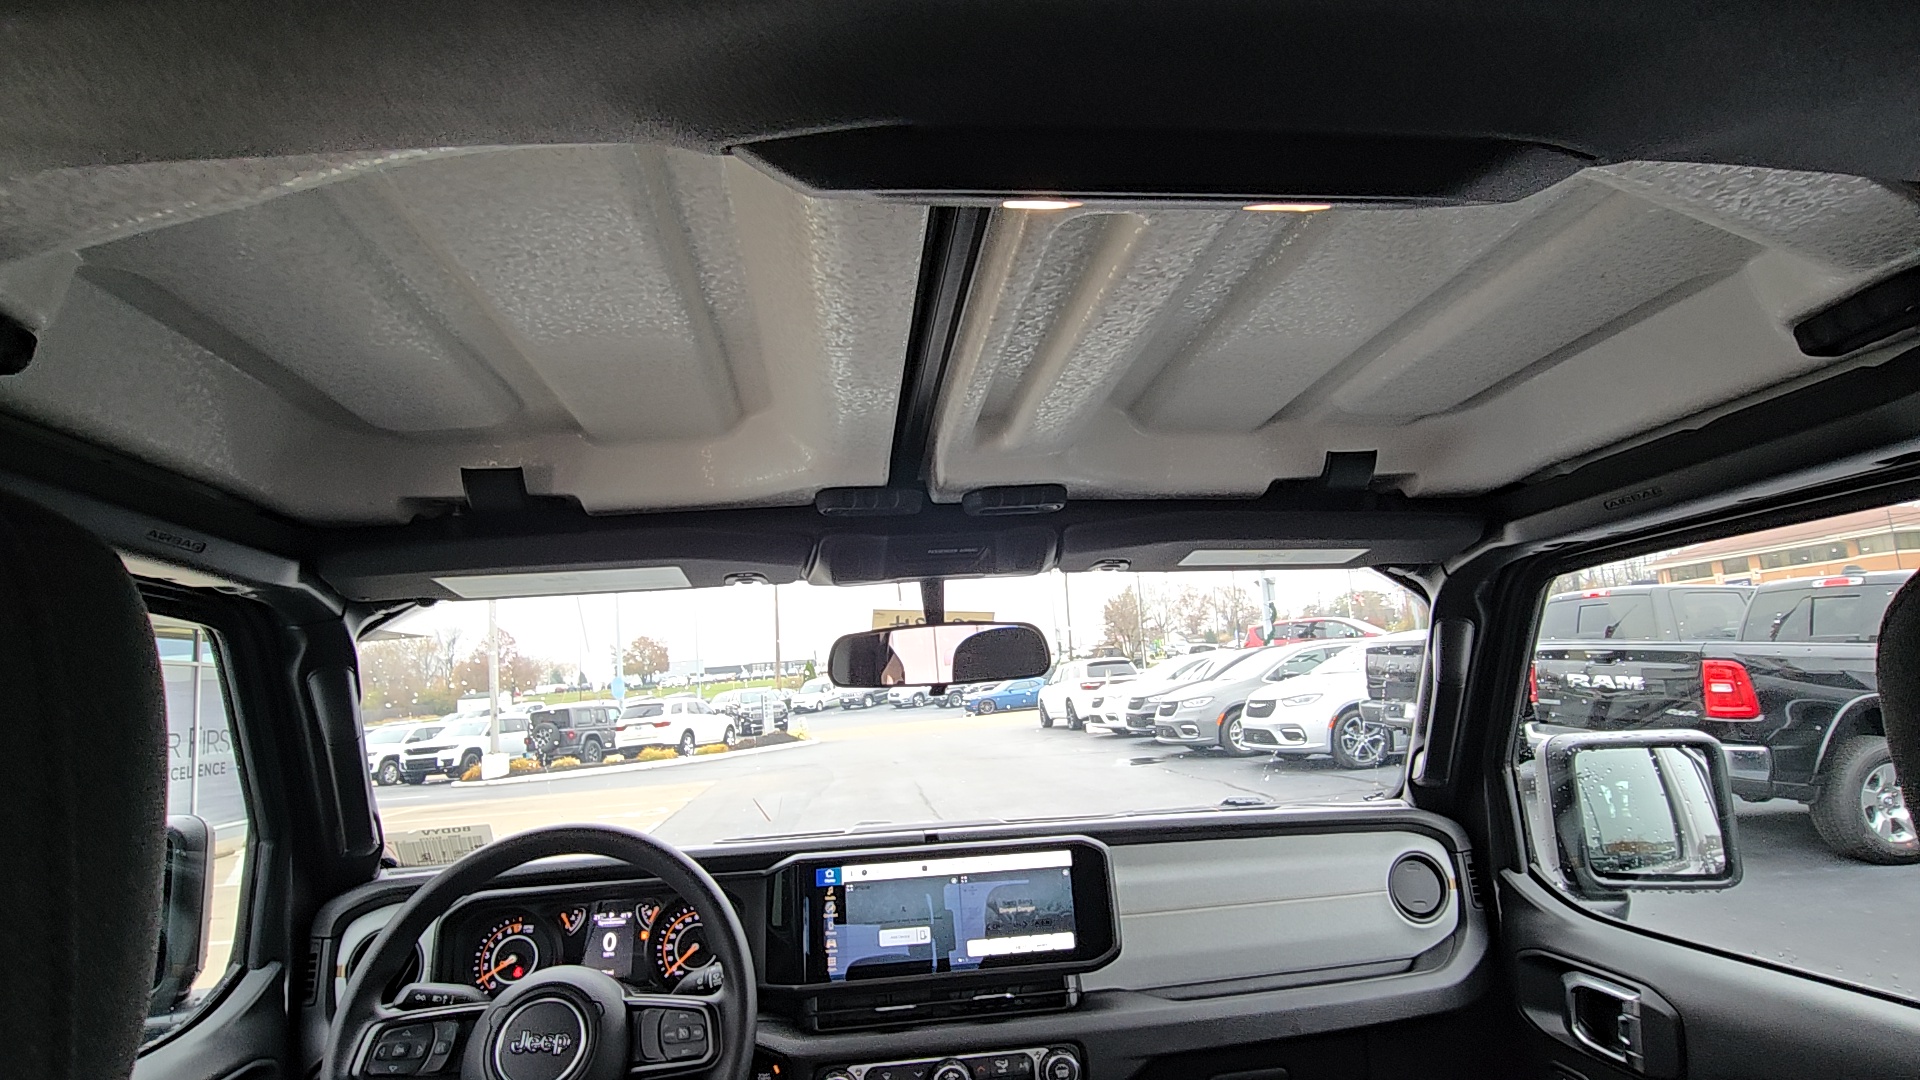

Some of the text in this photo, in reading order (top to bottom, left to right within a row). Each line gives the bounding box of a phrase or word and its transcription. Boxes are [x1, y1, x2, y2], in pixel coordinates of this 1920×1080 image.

[1566, 673, 1646, 690] RAM
[188, 726, 232, 758] FIRS
[170, 762, 226, 781] CELENCE
[603, 932, 617, 952] 0
[511, 1030, 571, 1055] Jeep
